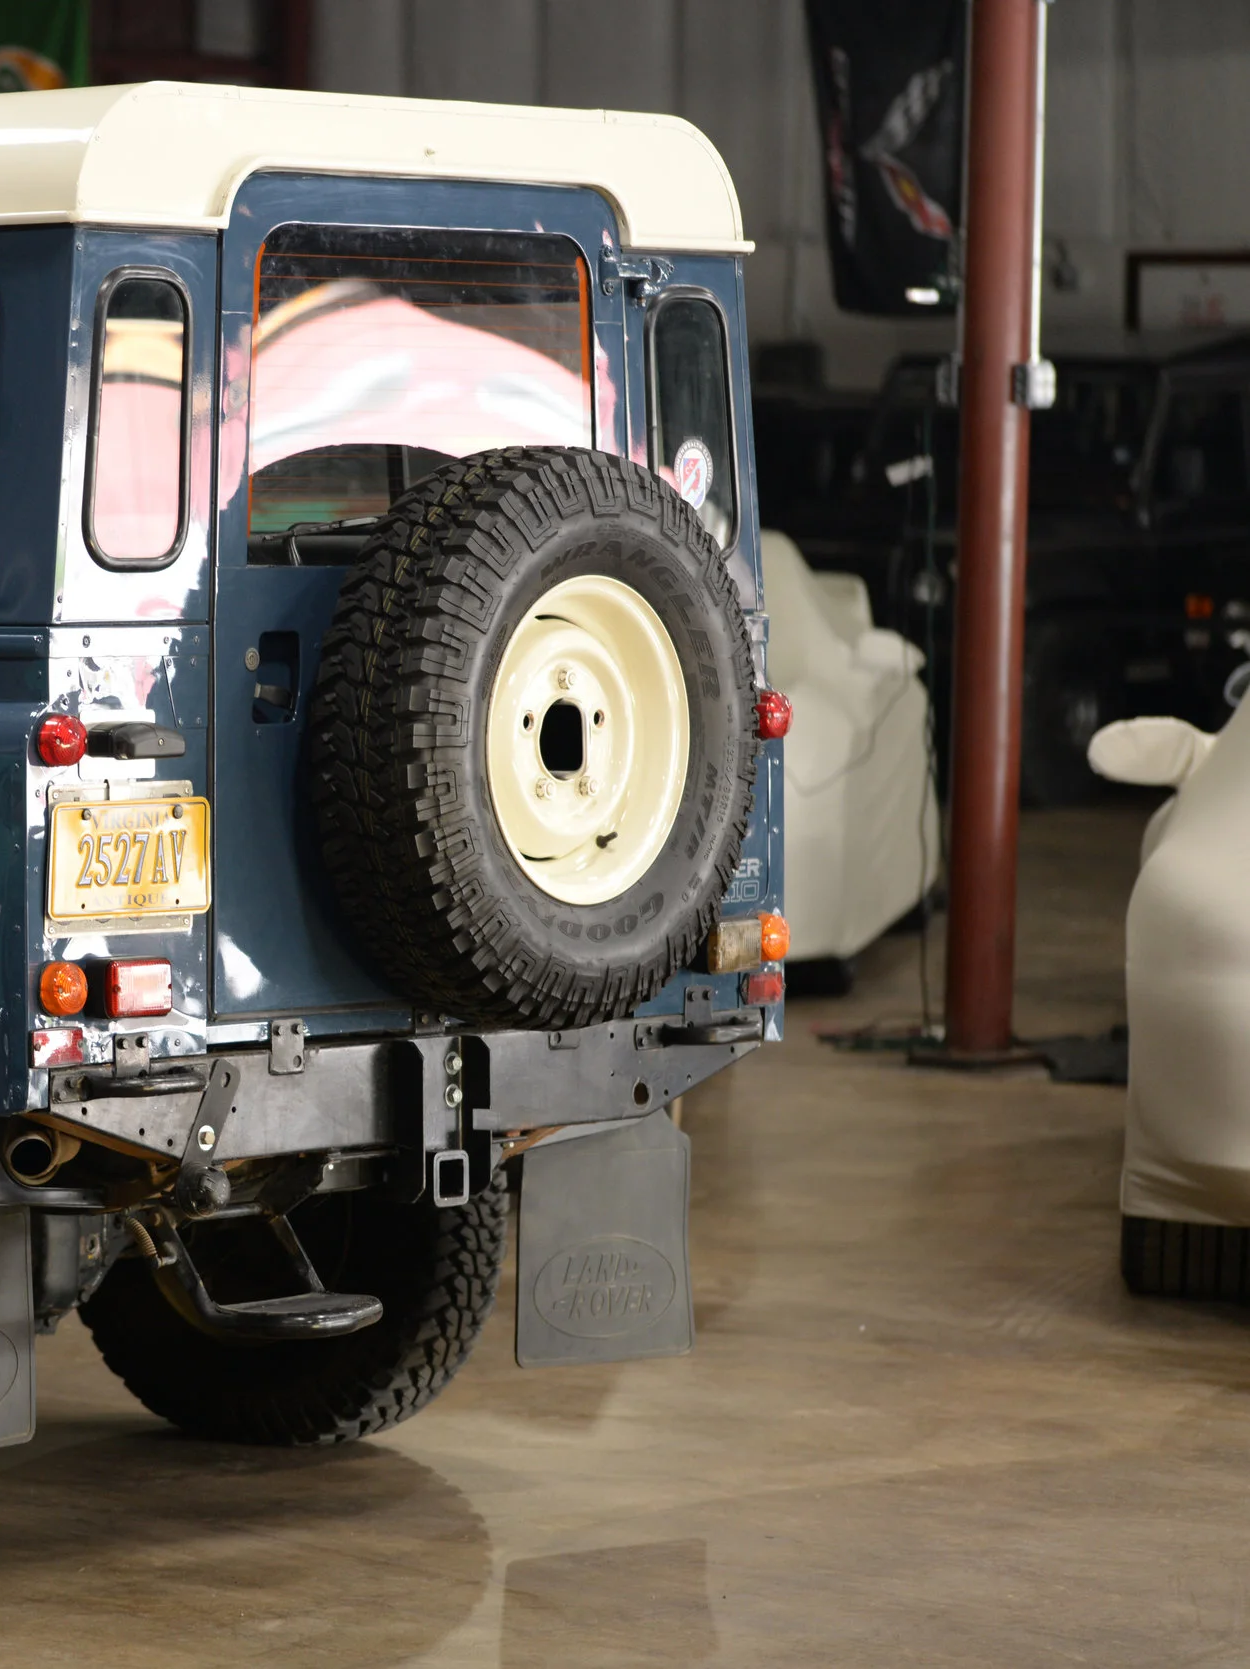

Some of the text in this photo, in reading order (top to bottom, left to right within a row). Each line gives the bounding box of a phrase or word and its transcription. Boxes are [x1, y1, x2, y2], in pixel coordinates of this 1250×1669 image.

[540, 540, 721, 700] WRANGLER
[91, 809, 171, 829] VIRGINIA
[93, 893, 168, 907] ANTIQUE
[567, 1283, 653, 1319] ROVER
